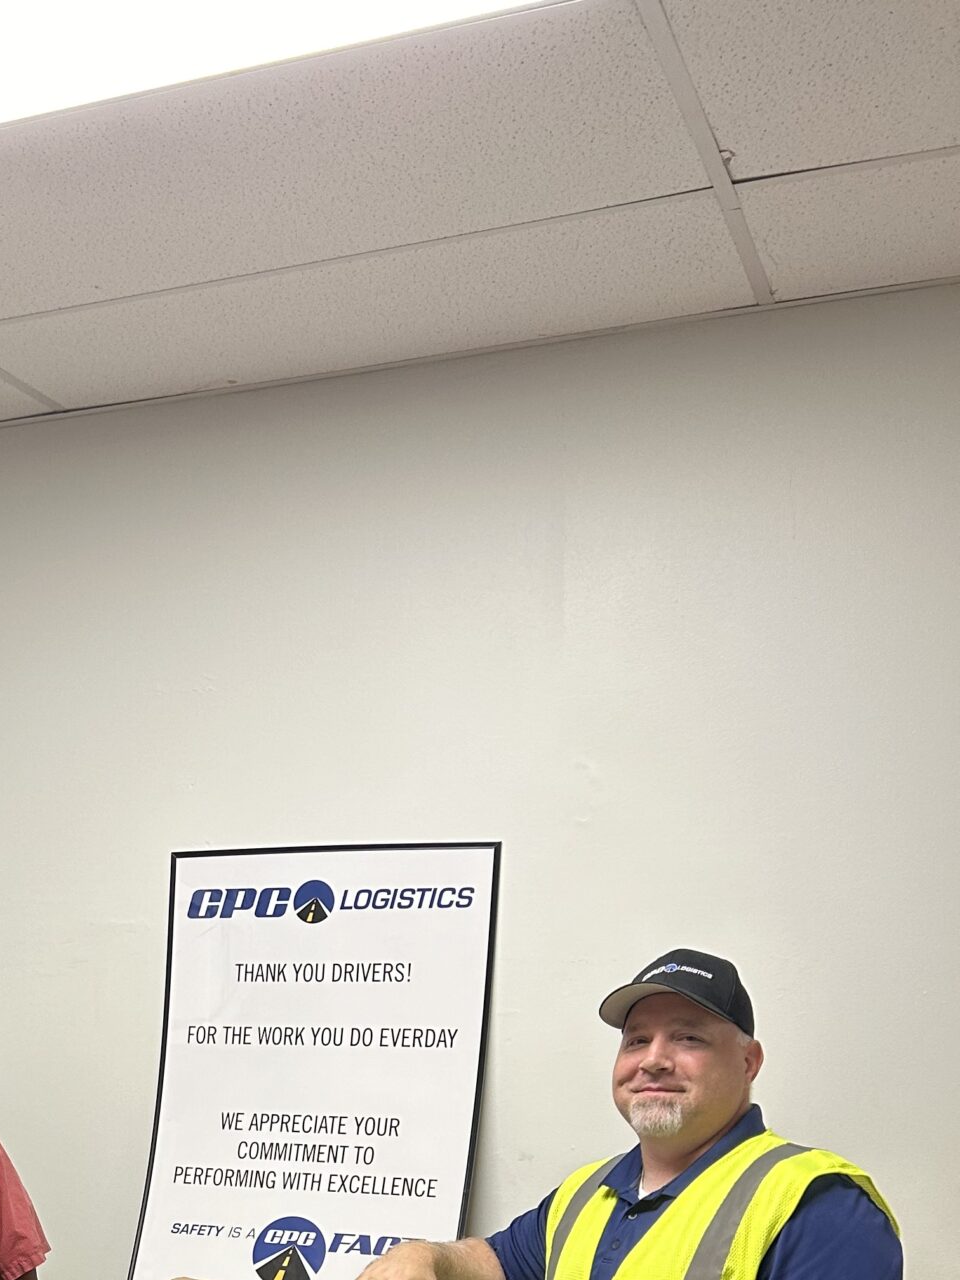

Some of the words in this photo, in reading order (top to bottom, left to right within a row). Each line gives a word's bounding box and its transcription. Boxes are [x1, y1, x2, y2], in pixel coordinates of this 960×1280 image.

[187, 887, 291, 919] CPC
[340, 887, 475, 910] LOGISTICS
[235, 963, 287, 982] THANK
[292, 963, 326, 982] YOU
[331, 963, 412, 983] DRIVERS!
[187, 1026, 217, 1044] FOR
[223, 1026, 252, 1045] THE
[257, 1026, 305, 1046] WORK
[310, 1027, 344, 1047] YOU
[350, 1028, 373, 1047] DO
[379, 1028, 458, 1048] EVERDAY
[221, 1112, 243, 1130] WE
[248, 1113, 348, 1135] APPRECIATE
[355, 1117, 400, 1137] YOUR
[237, 1141, 349, 1163] COMMITMENT
[354, 1146, 375, 1165] TO
[173, 1166, 277, 1189] PERFORMING
[282, 1172, 322, 1192] WITH
[327, 1177, 438, 1198] EXCELLENCE
[171, 1222, 224, 1237] SAFETY
[228, 1226, 241, 1238] IS
[246, 1228, 255, 1239] A
[264, 1229, 317, 1246] CPC
[328, 1233, 426, 1256] FAC
